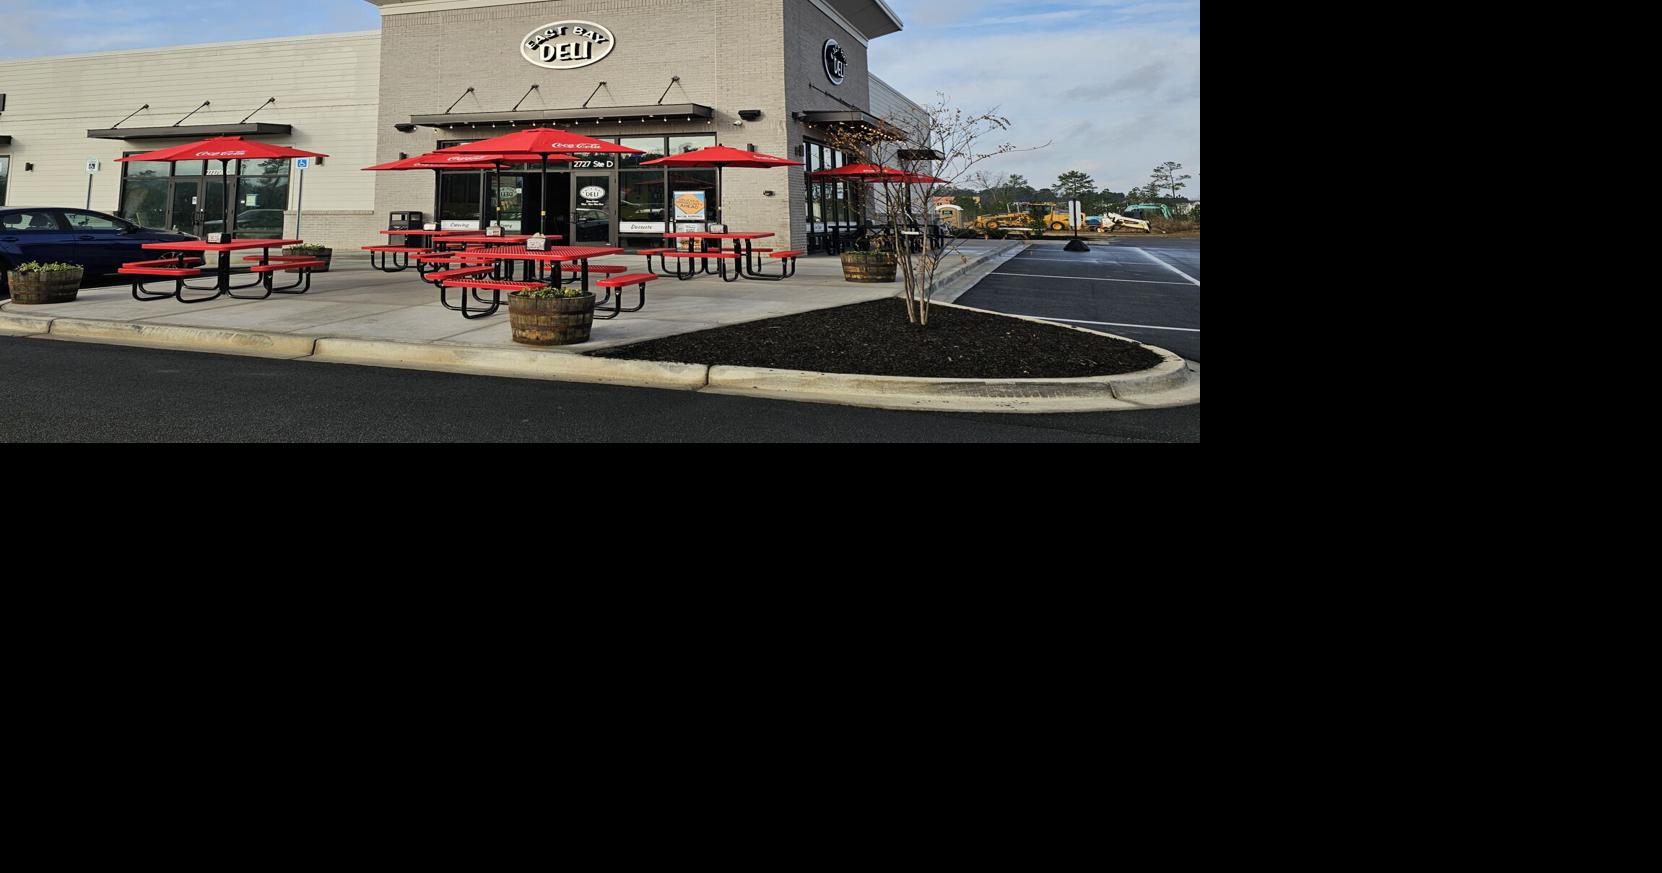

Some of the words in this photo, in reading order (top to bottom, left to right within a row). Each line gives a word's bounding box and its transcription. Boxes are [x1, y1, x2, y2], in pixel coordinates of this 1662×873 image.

[525, 26, 568, 50] EAST
[572, 26, 609, 44] BAY
[540, 41, 592, 62] DELI
[573, 160, 591, 168] 2727
[593, 160, 605, 168] Ste
[606, 160, 614, 168] D
